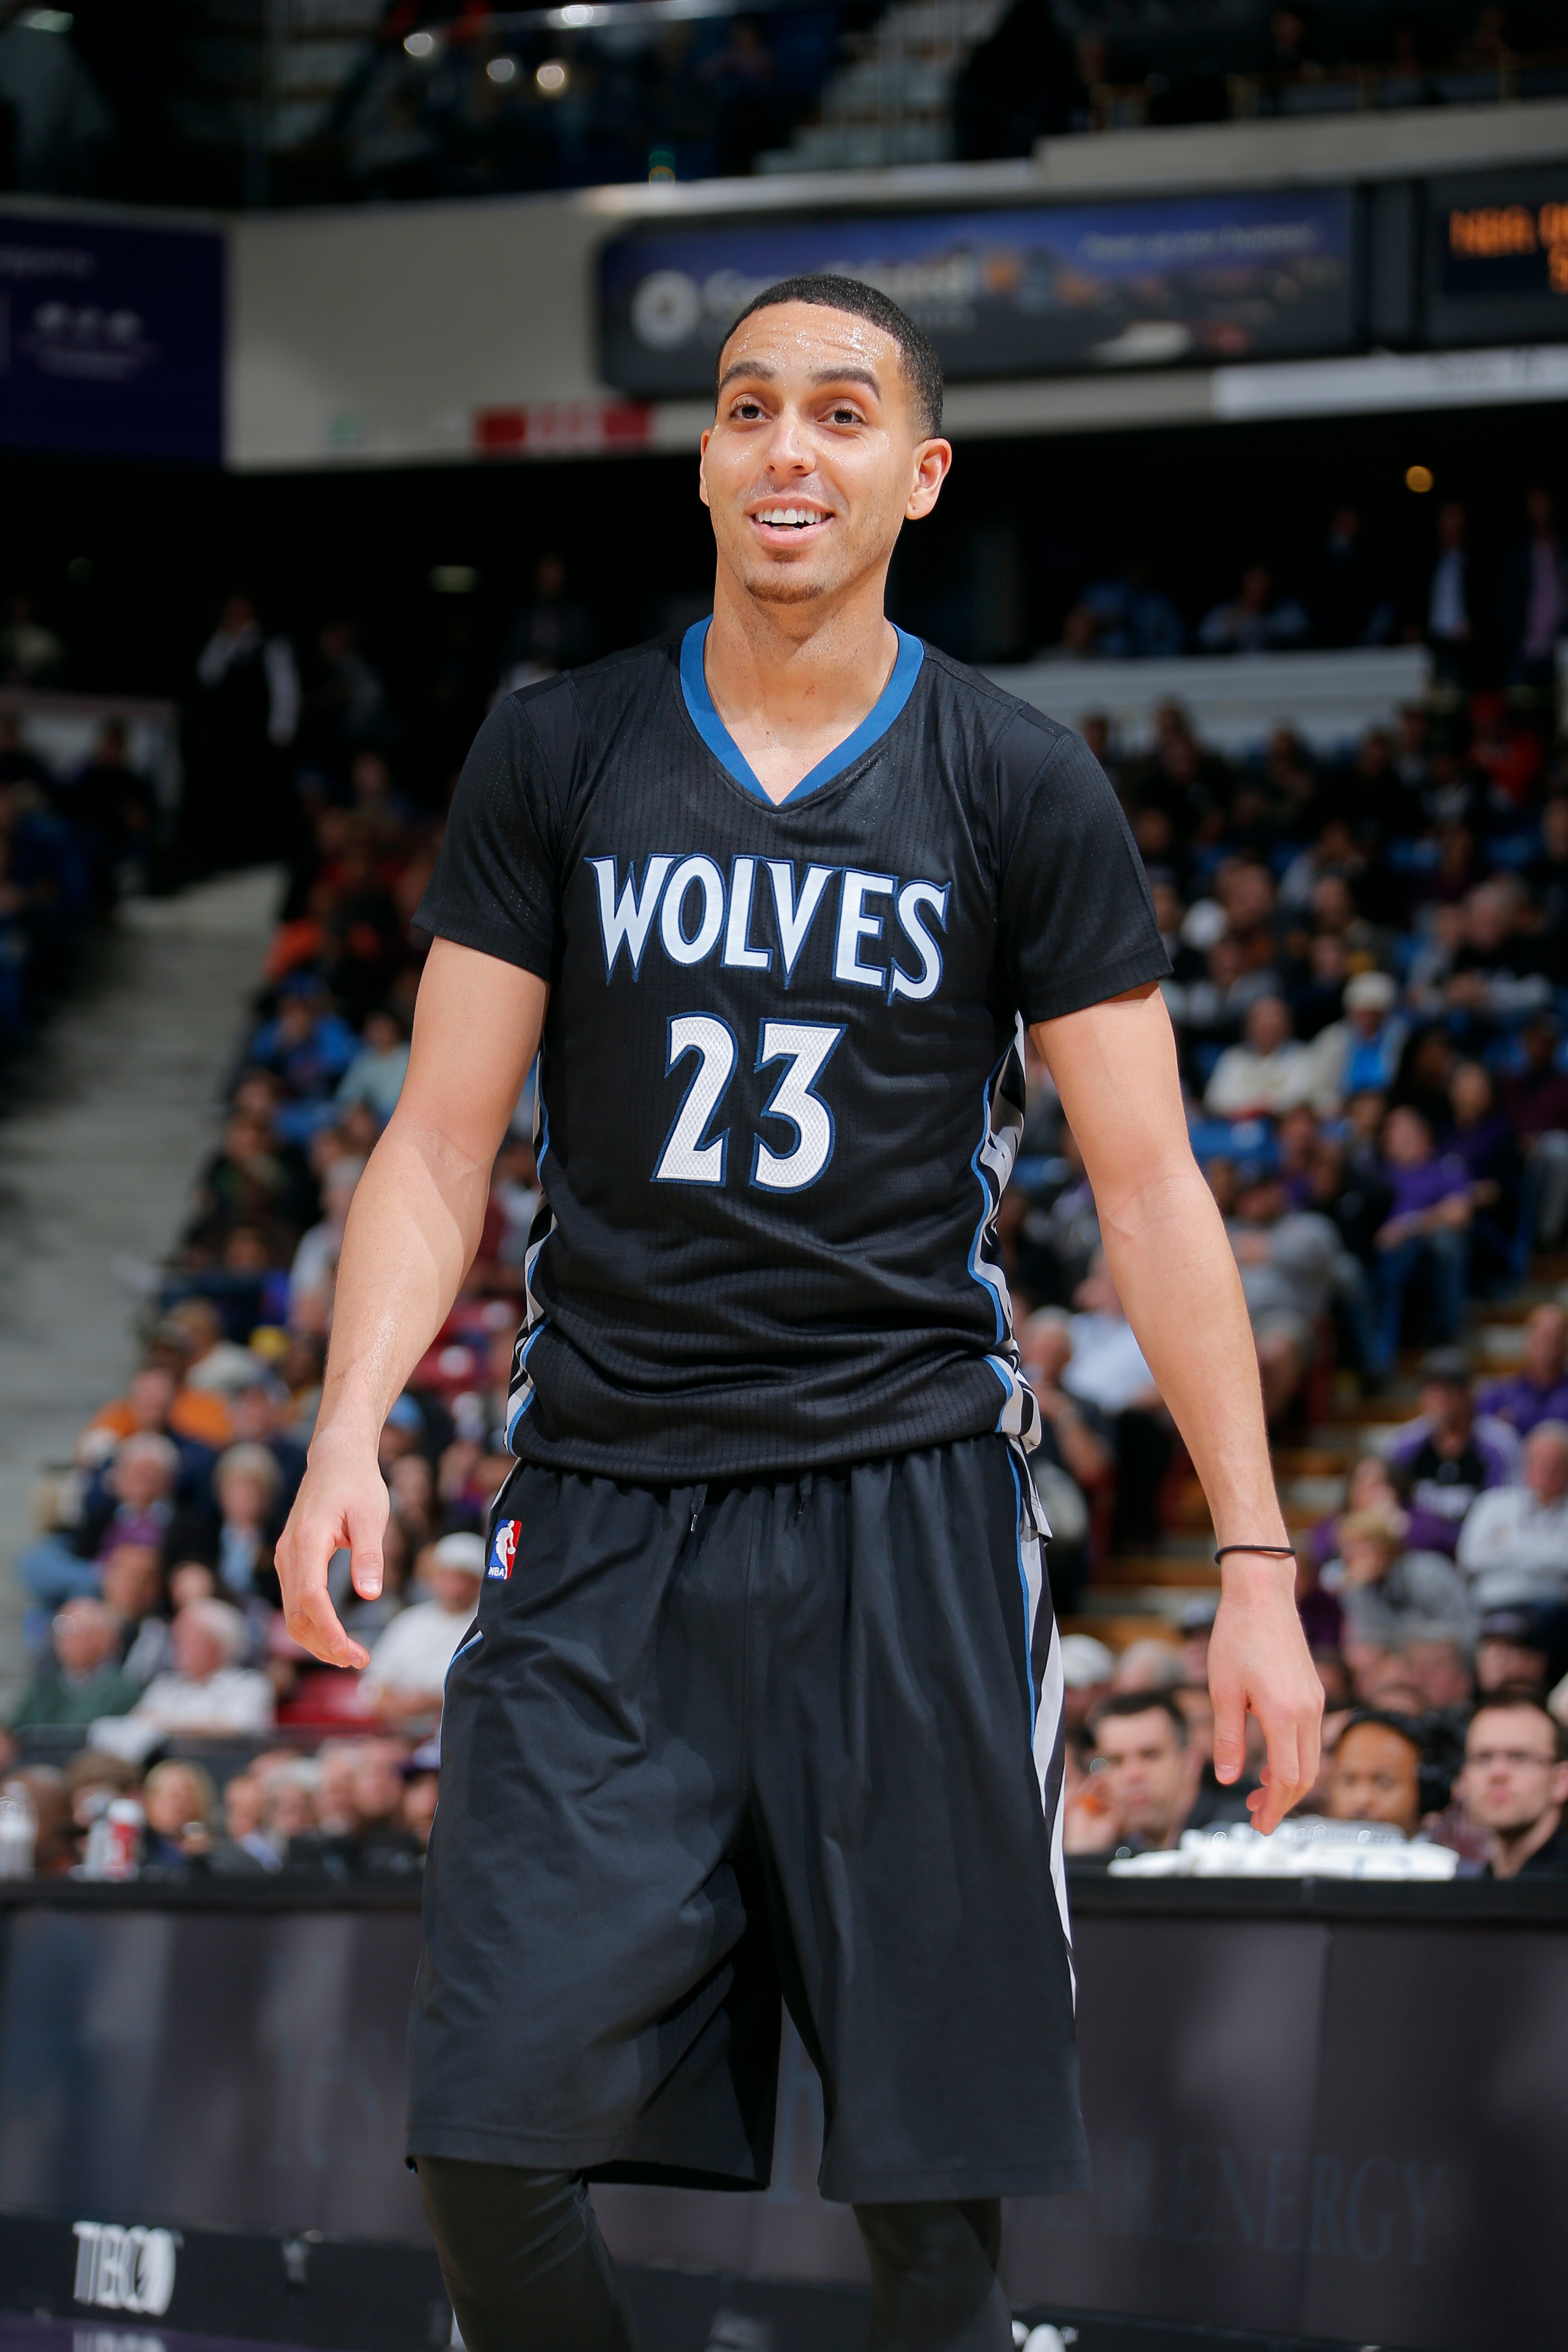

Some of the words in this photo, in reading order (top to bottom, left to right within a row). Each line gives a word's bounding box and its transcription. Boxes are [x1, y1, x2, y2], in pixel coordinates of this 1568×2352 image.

[583, 852, 952, 1006] WOLVES
[650, 1011, 848, 1194] 23
[488, 1566, 505, 1577] NBA
[1174, 2147, 1445, 2265] ENERGY
